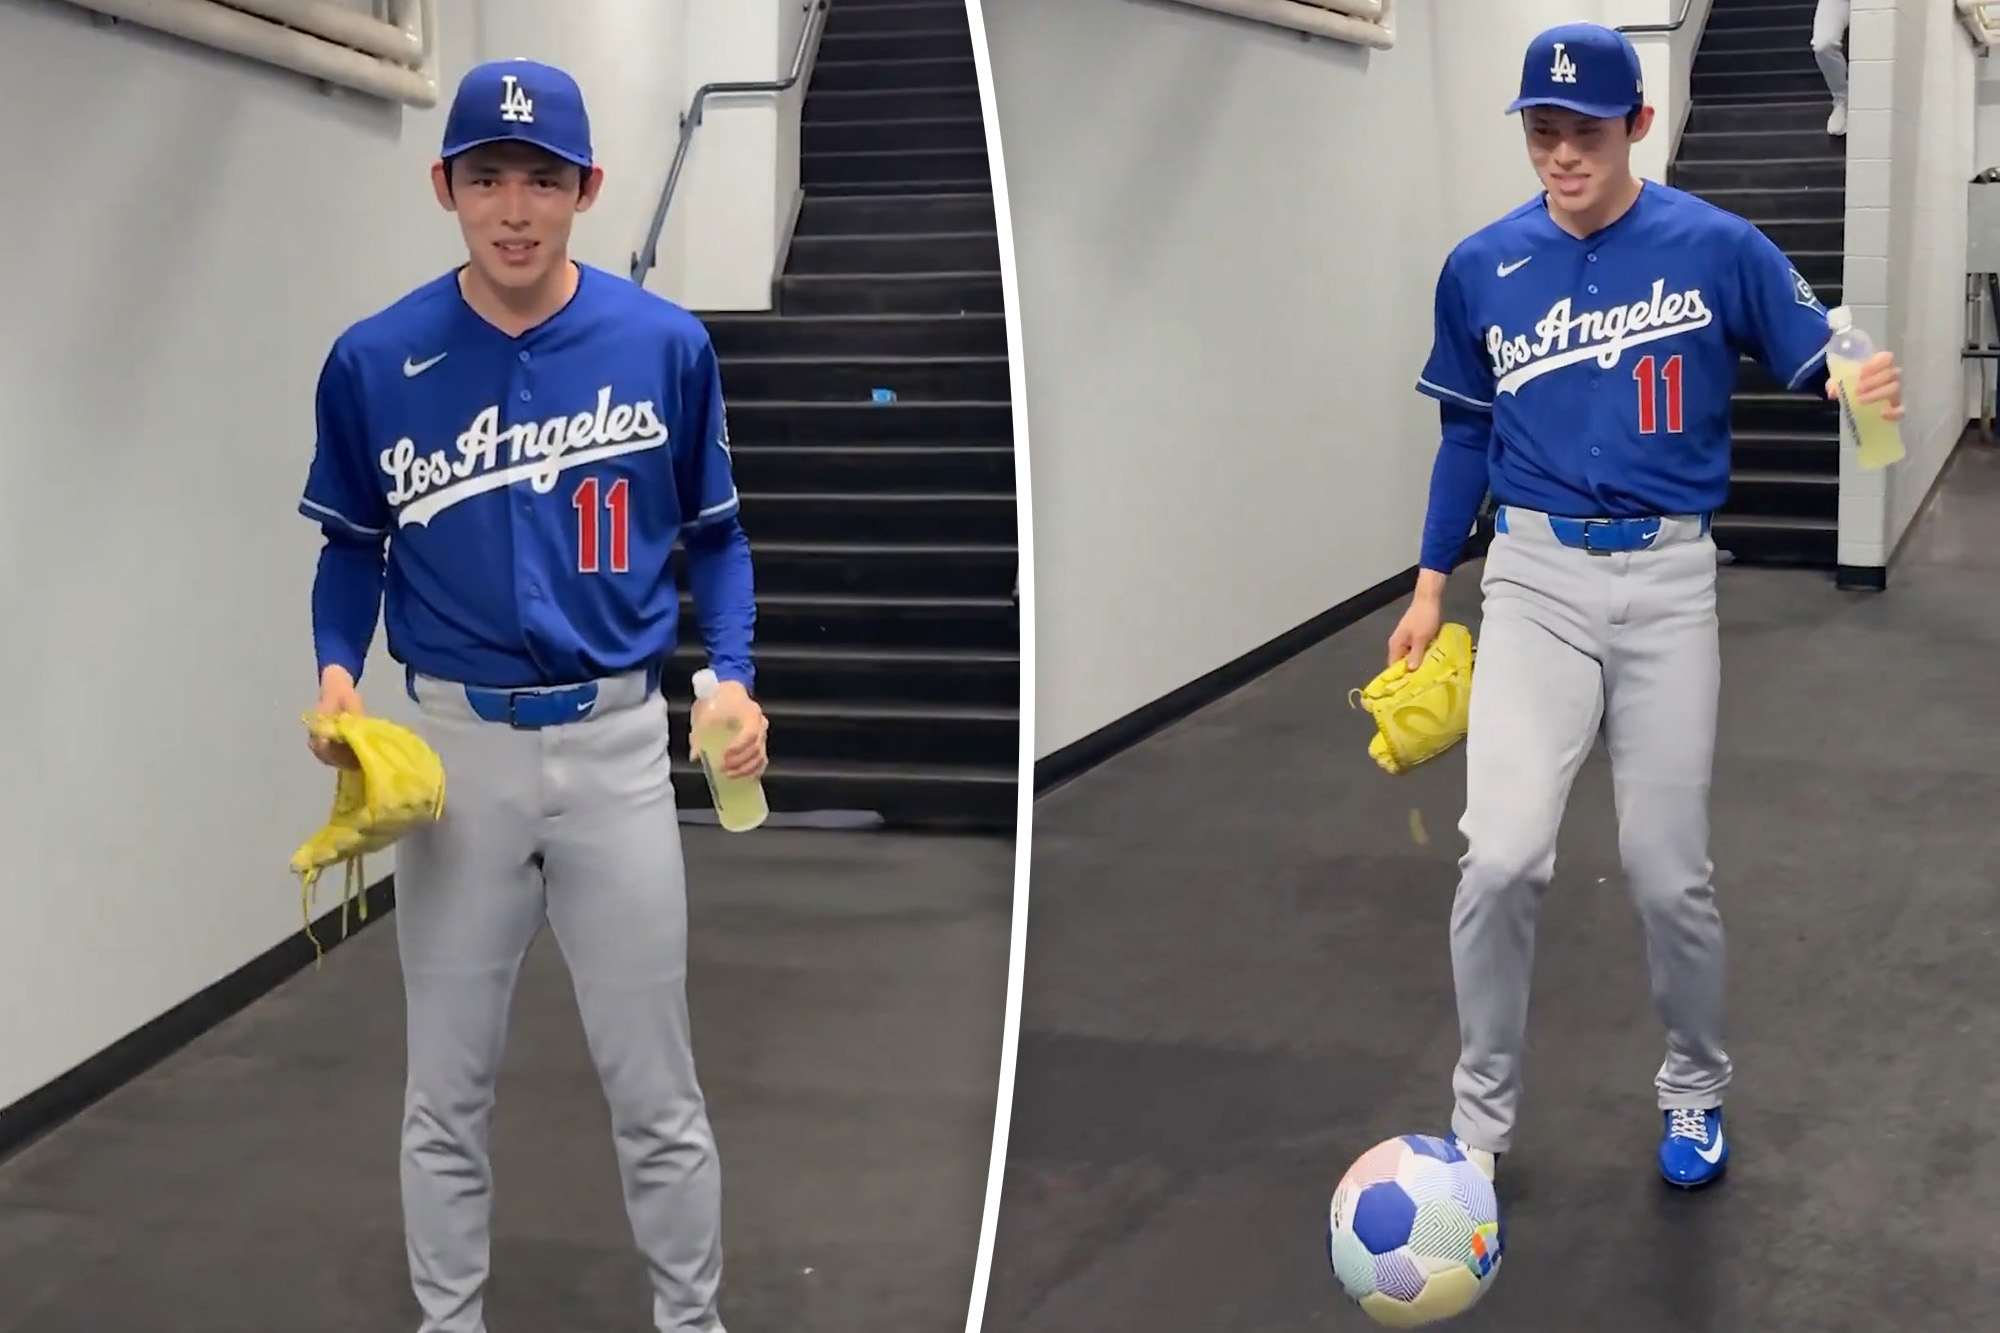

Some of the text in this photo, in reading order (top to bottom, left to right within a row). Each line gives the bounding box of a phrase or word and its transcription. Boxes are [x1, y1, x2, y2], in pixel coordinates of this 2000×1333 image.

[500, 75, 533, 122] LA
[1550, 43, 1577, 83] LA
[1486, 278, 1713, 378] Los Angeles
[1633, 354, 1683, 434] 11
[380, 384, 668, 505] Los Angeles
[572, 477, 629, 573] 11
